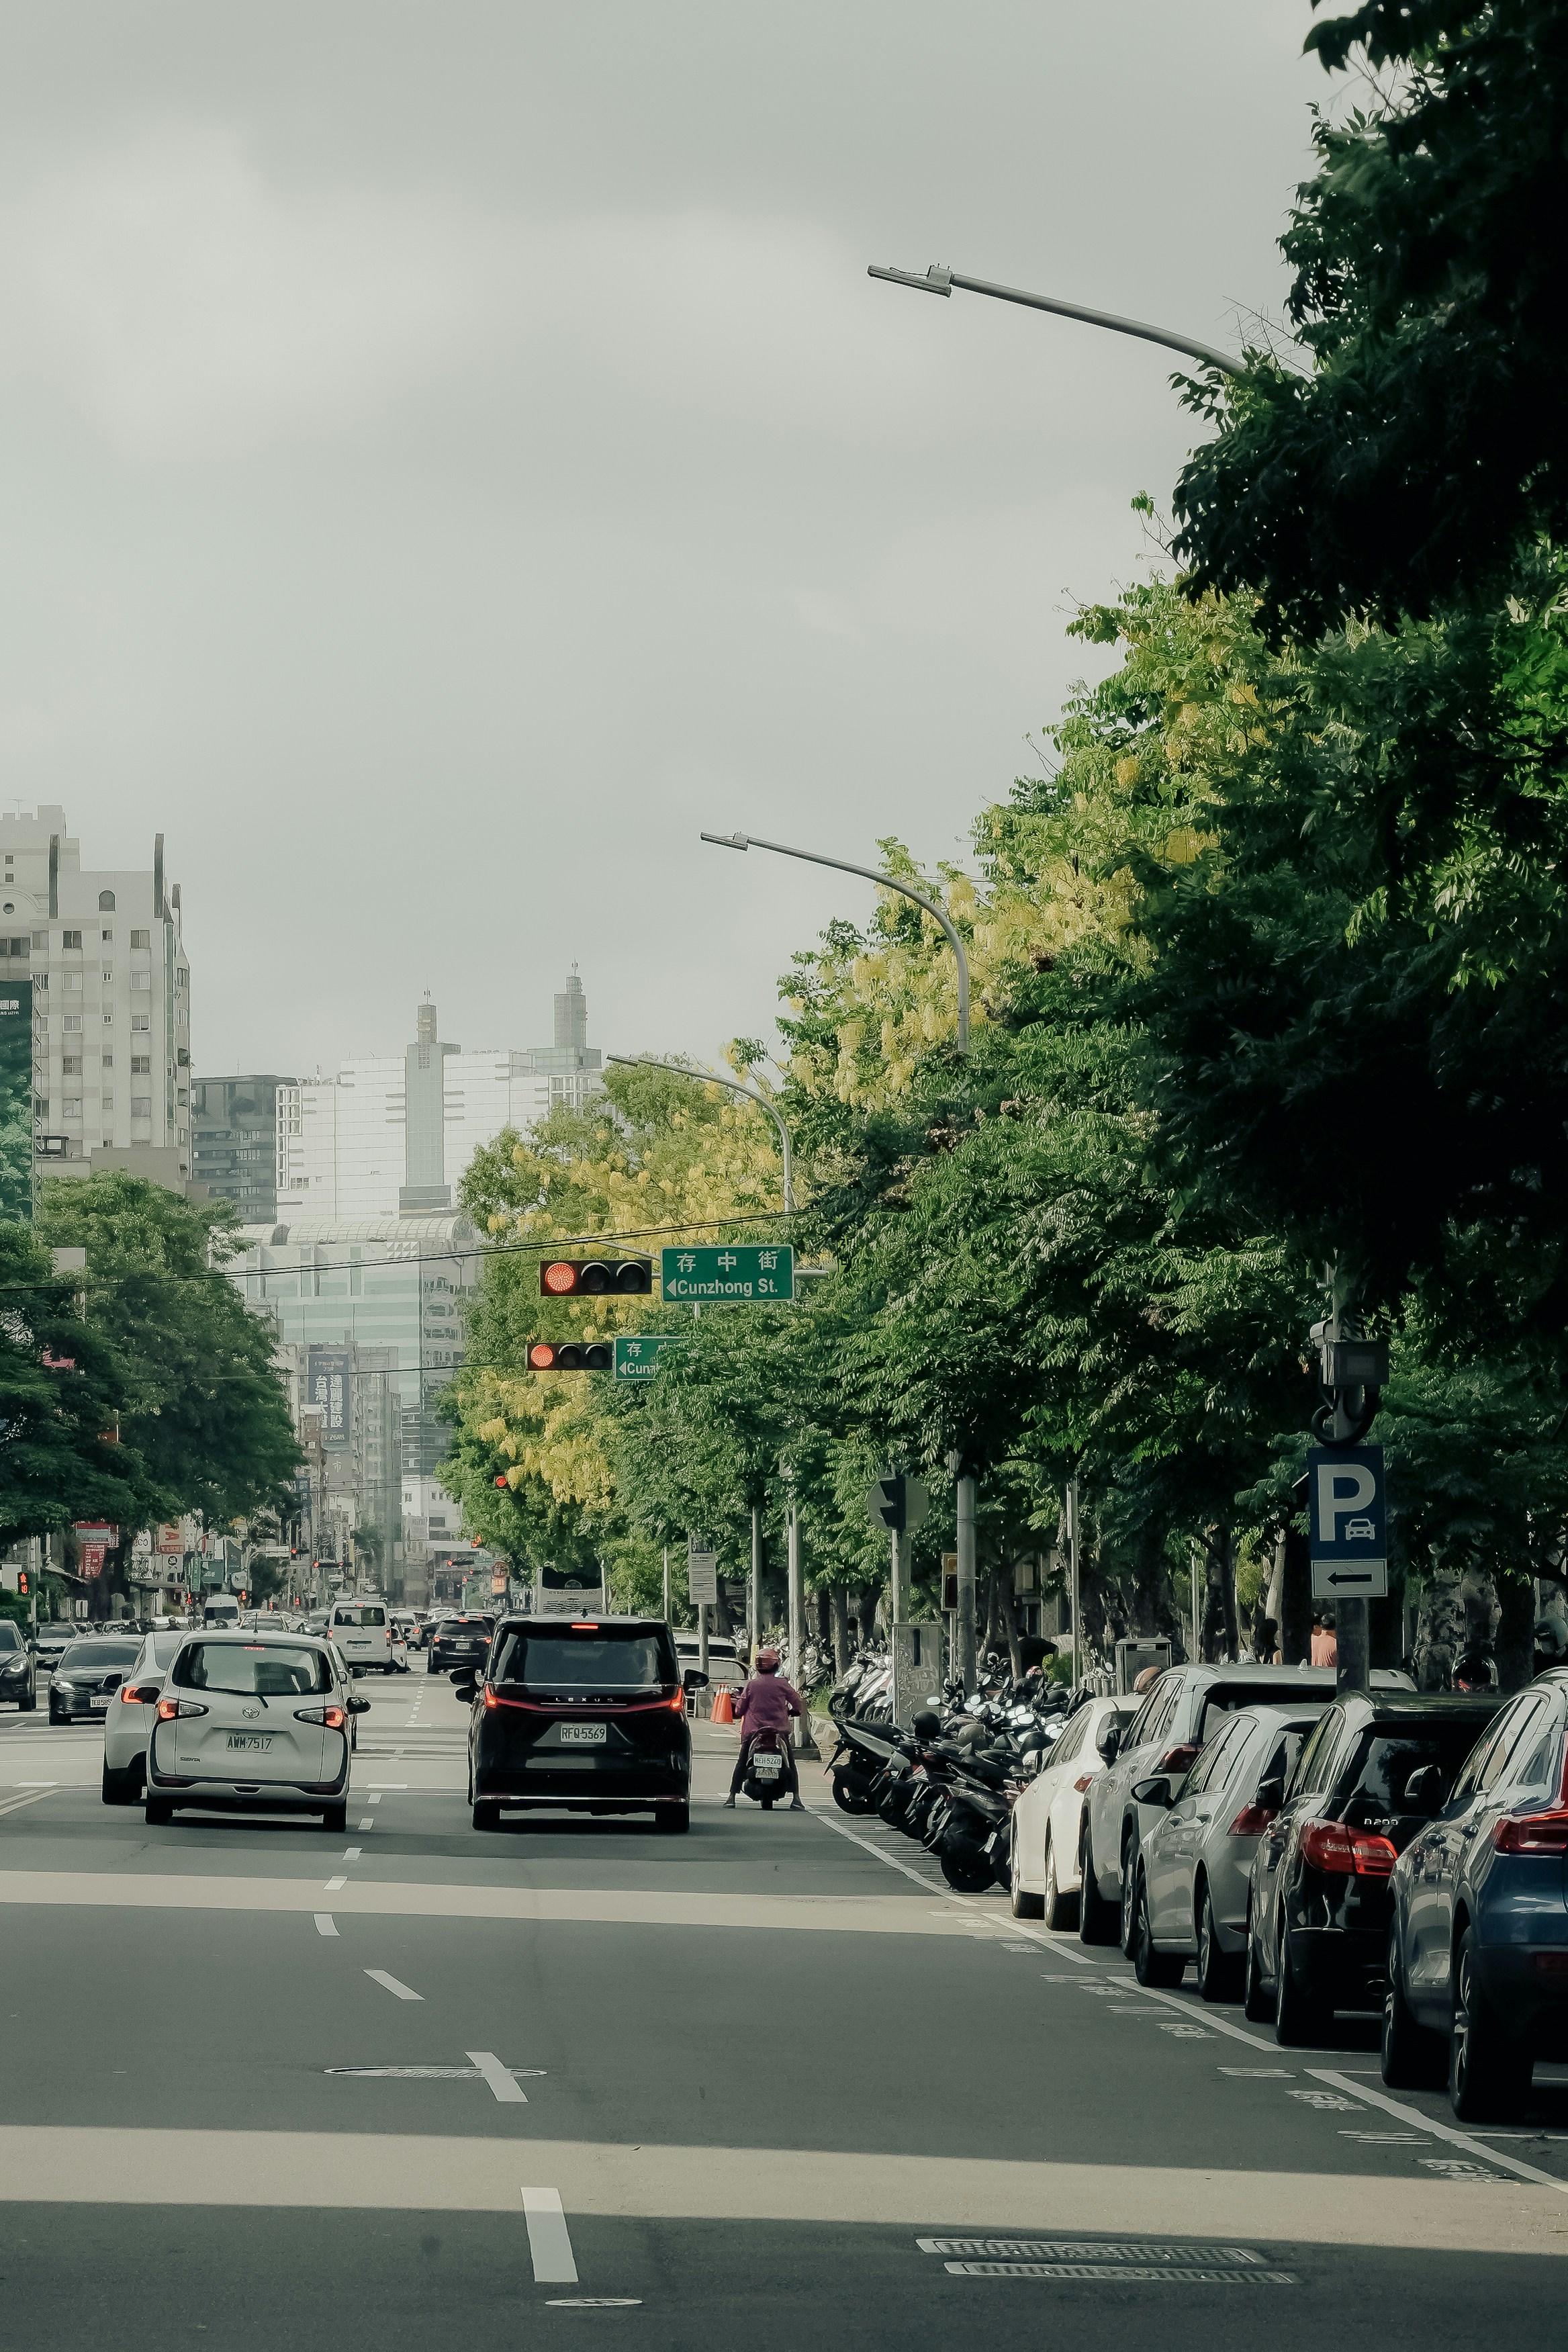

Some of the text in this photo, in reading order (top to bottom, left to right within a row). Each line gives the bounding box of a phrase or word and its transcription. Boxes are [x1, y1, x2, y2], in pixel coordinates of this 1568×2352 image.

[676, 1251, 778, 1273] 存中街
[678, 1278, 778, 1297] Cunzhong St.
[1317, 1464, 1376, 1542] P
[228, 1735, 273, 1750] AWM-7517
[561, 1727, 605, 1739] RFQ-5369
